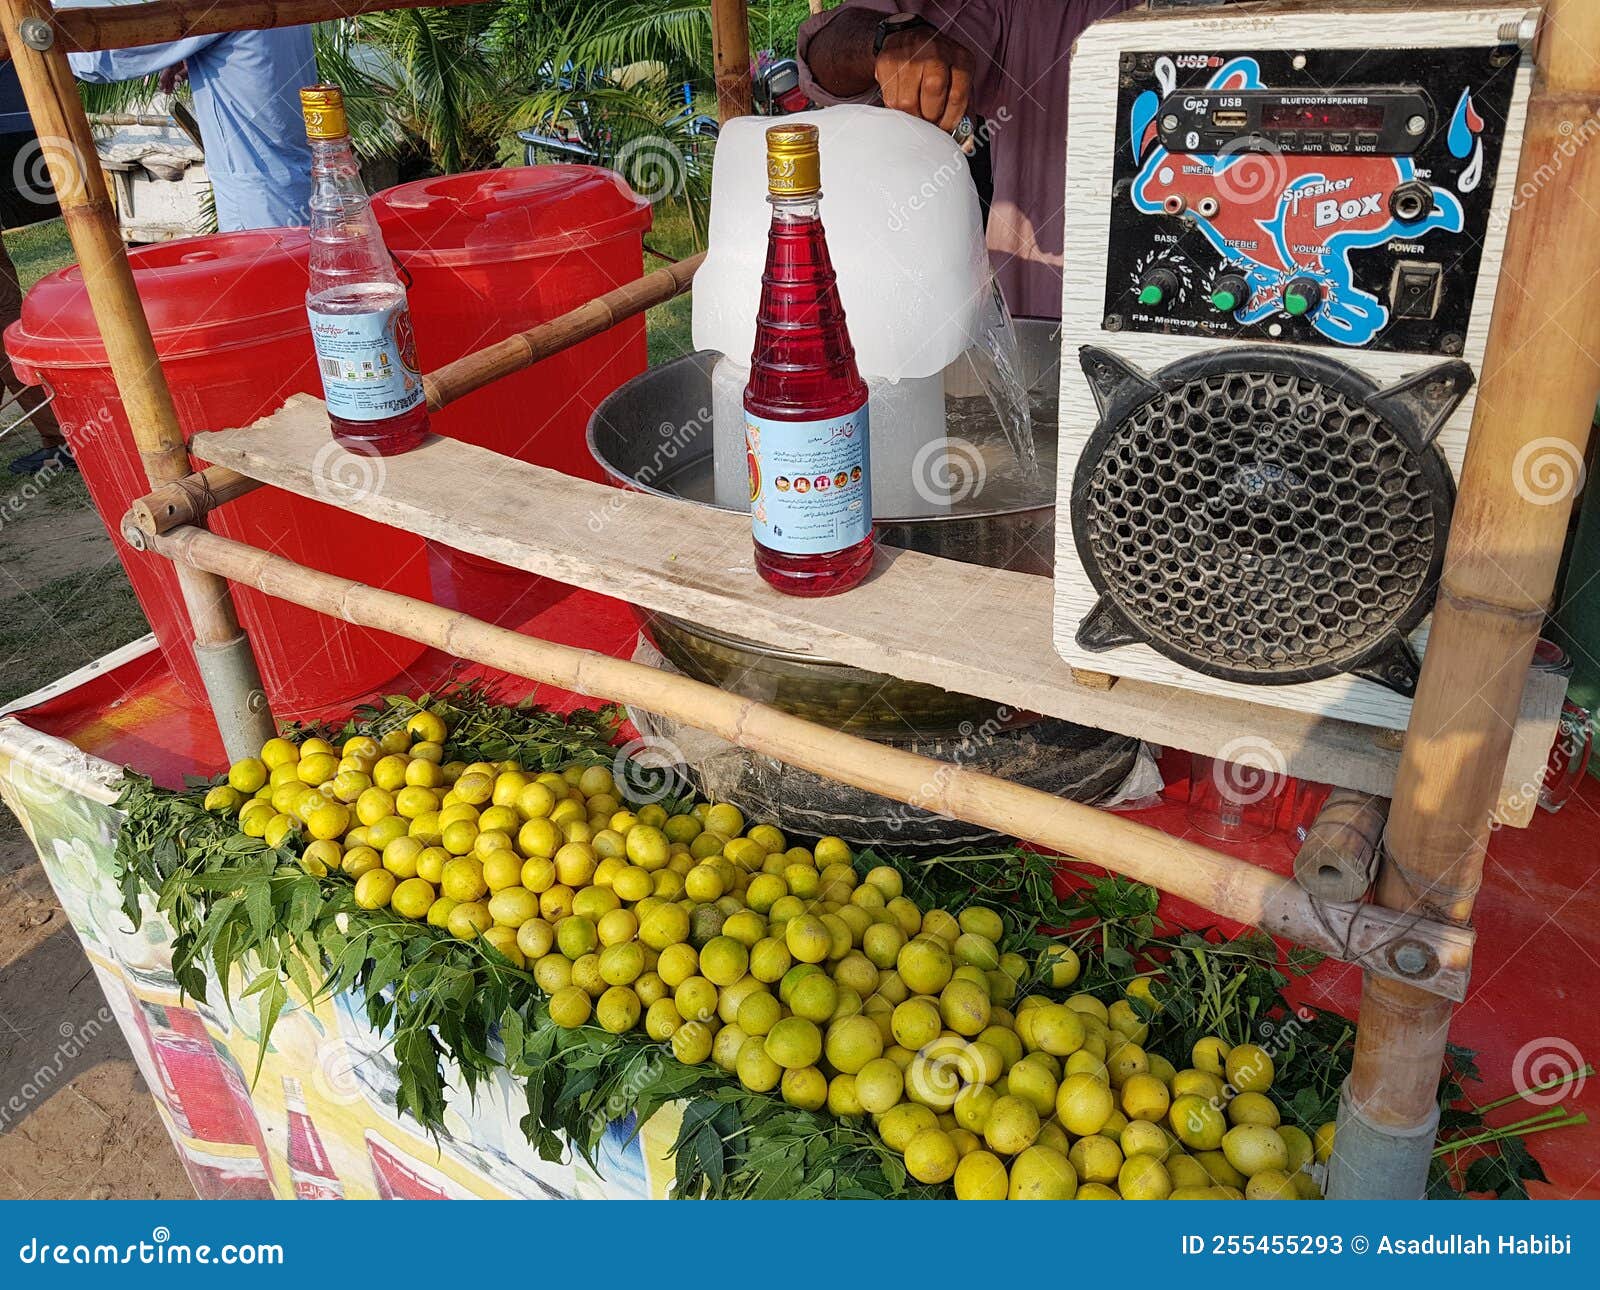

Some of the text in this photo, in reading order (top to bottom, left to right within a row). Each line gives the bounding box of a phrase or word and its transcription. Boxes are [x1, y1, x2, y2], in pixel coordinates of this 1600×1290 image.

[1176, 55, 1208, 68] USB
[1219, 98, 1242, 107] USB
[1281, 97, 1368, 105] BLUETOOTH SPEAKERS
[1303, 144, 1323, 152] AUTO
[1203, 165, 1215, 176] IN
[1413, 168, 1432, 178] MIC
[1283, 176, 1354, 217] Speaker
[1154, 234, 1178, 243] BASS
[1223, 239, 1258, 250] TREBLE
[1292, 244, 1331, 255] VOLUME
[1387, 242, 1425, 254] POWER
